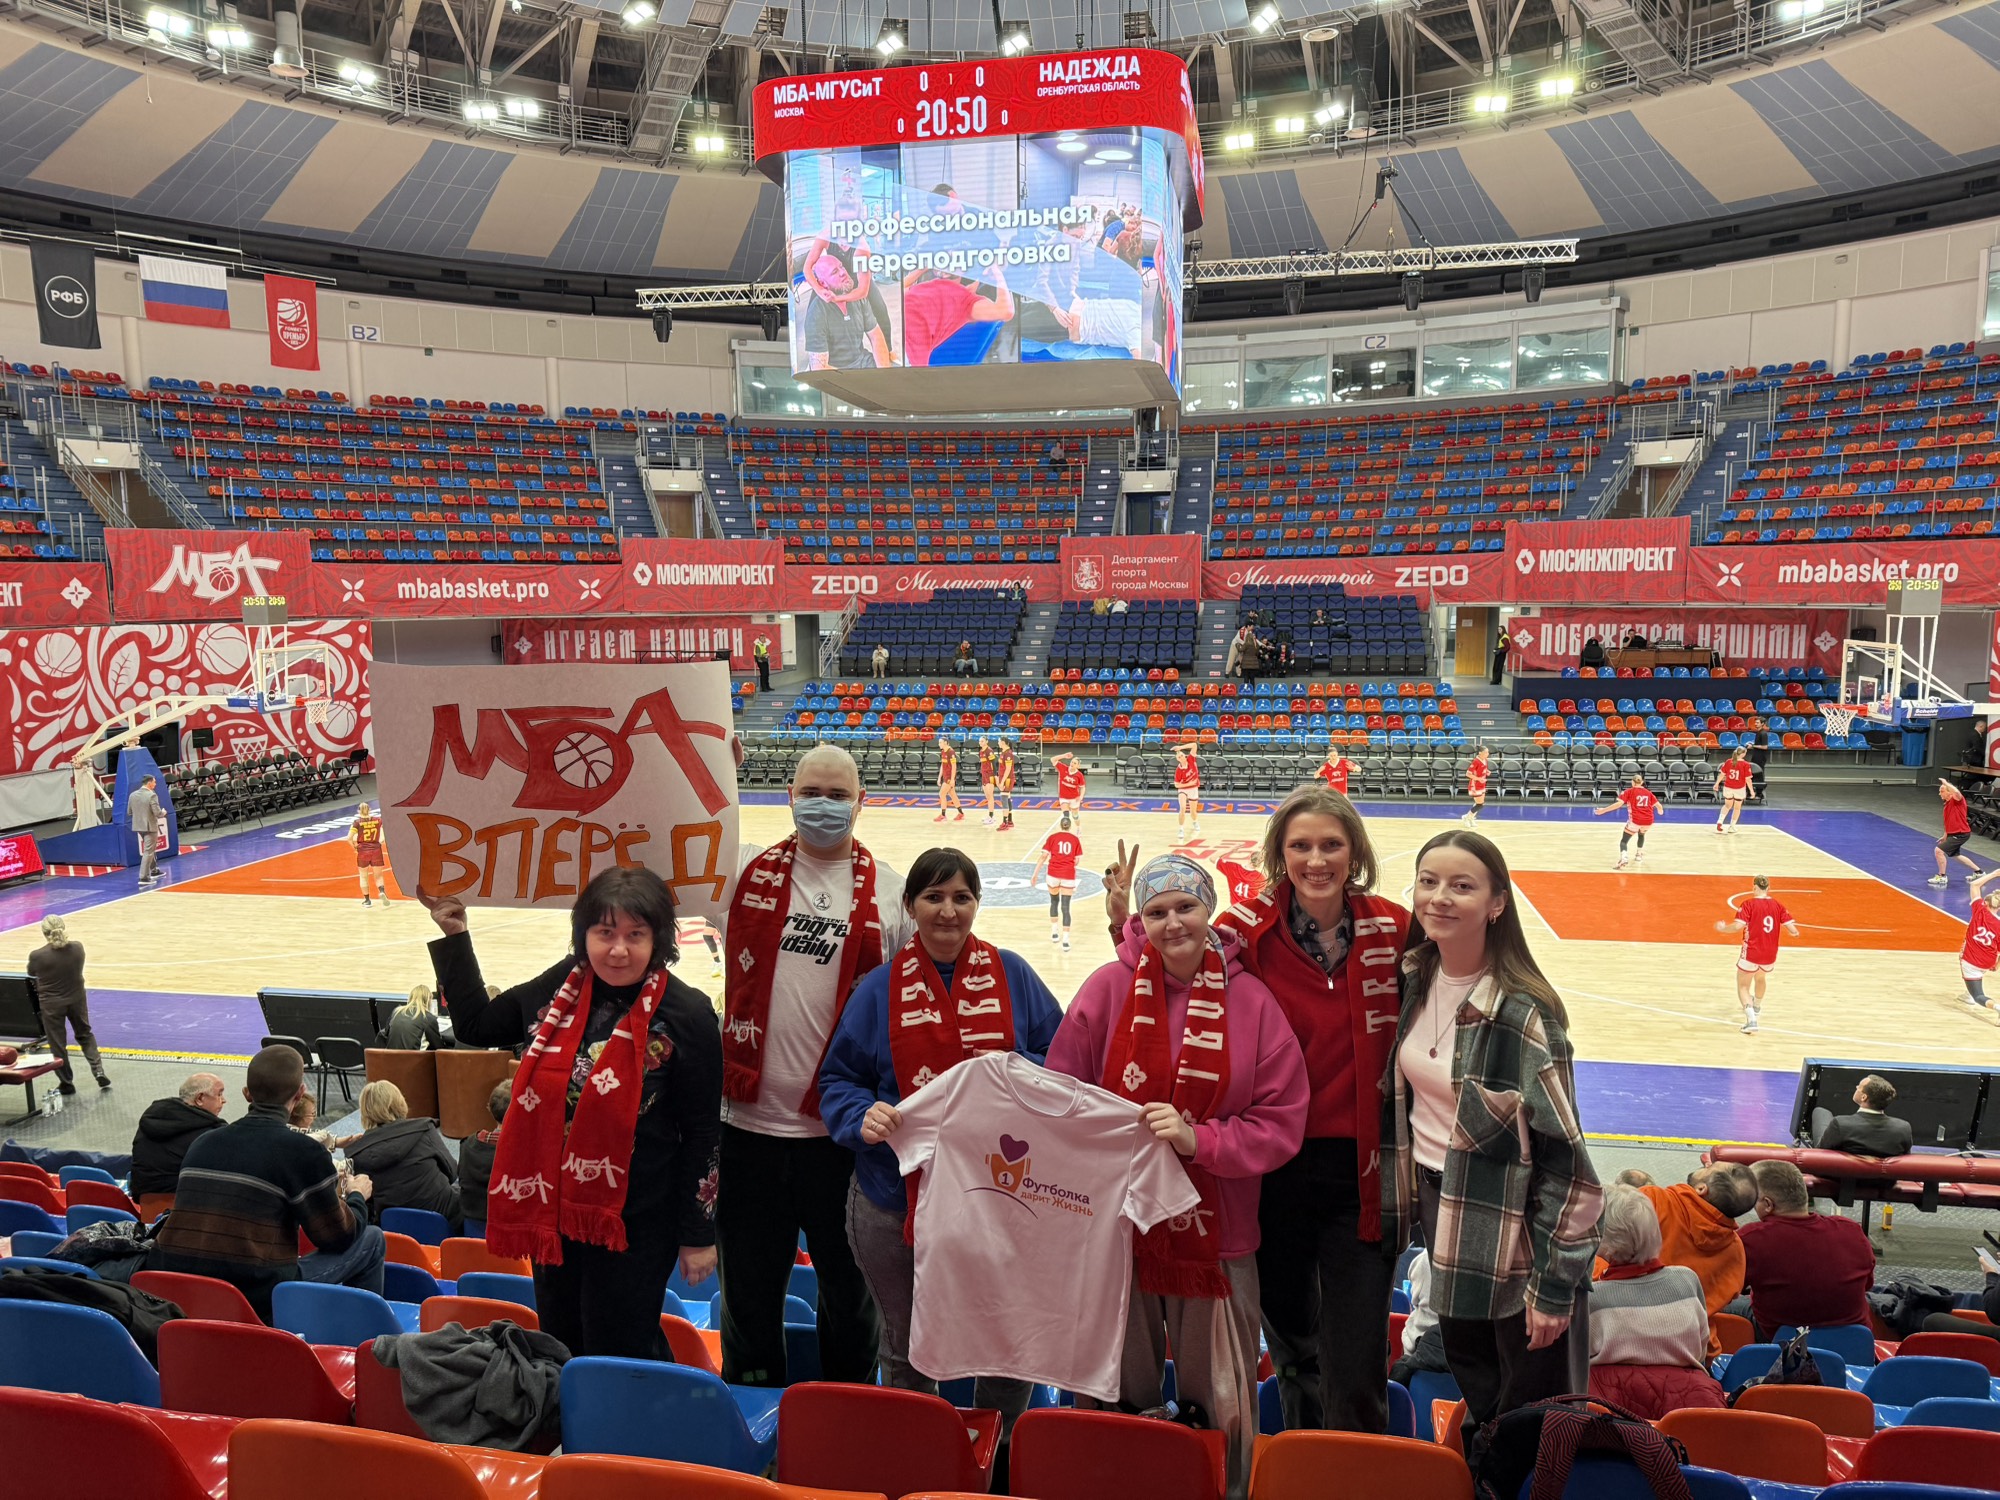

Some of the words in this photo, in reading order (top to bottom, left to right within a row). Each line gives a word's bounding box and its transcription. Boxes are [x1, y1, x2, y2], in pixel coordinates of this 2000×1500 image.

[975, 65, 985, 88] 0
[1038, 55, 1142, 83] НАДЕЖДА
[773, 75, 884, 105] МБА-МГУСиТ
[919, 71, 929, 93] 0
[1036, 83, 1099, 98] ОРЕНБУРГСКАЯ
[1101, 79, 1141, 94] ОБЛАСТЬ
[774, 106, 805, 119] МОСКВА
[915, 95, 988, 138] 20:50
[1001, 109, 1009, 126] 0
[897, 117, 905, 134] 0
[830, 204, 1093, 243] профессиональная
[852, 242, 1072, 278] переподготовка
[50, 289, 84, 305] РФБ
[1111, 554, 1179, 567] Департамент
[1539, 546, 1677, 573] МОСИНЖПРОЕКТ
[656, 563, 776, 587] МОСИНЖПРОЕКТ
[1111, 568, 1147, 580] спорта
[1394, 564, 1470, 588] ZEDO
[1778, 557, 1960, 585] mbabasket.pro
[397, 577, 550, 603] mbabasket.pro
[811, 574, 879, 596] ZEDO
[1111, 580, 1147, 593] города
[1149, 578, 1190, 591] Москвы
[1906, 579, 1940, 591] 20:50
[243, 596, 266, 606] 20:50
[268, 596, 286, 606] 20:50
[544, 628, 637, 661] ИГРАЕМ
[650, 627, 744, 658] НАШИМИ
[391, 686, 731, 818] МБА
[1729, 769, 1741, 781] 31
[1636, 795, 1650, 807] 27
[362, 827, 378, 842] 27
[1057, 840, 1072, 856] 10
[1234, 883, 1250, 898] 41
[1763, 915, 1775, 934] 9
[1972, 926, 1996, 946] 25
[561, 1151, 626, 1189] МБА
[1001, 1172, 1010, 1185] 1
[488, 1171, 555, 1205] МБА
[1022, 1176, 1090, 1205] Футболка
[1020, 1189, 1051, 1205] дарит
[1051, 1195, 1094, 1217] Жизнь
